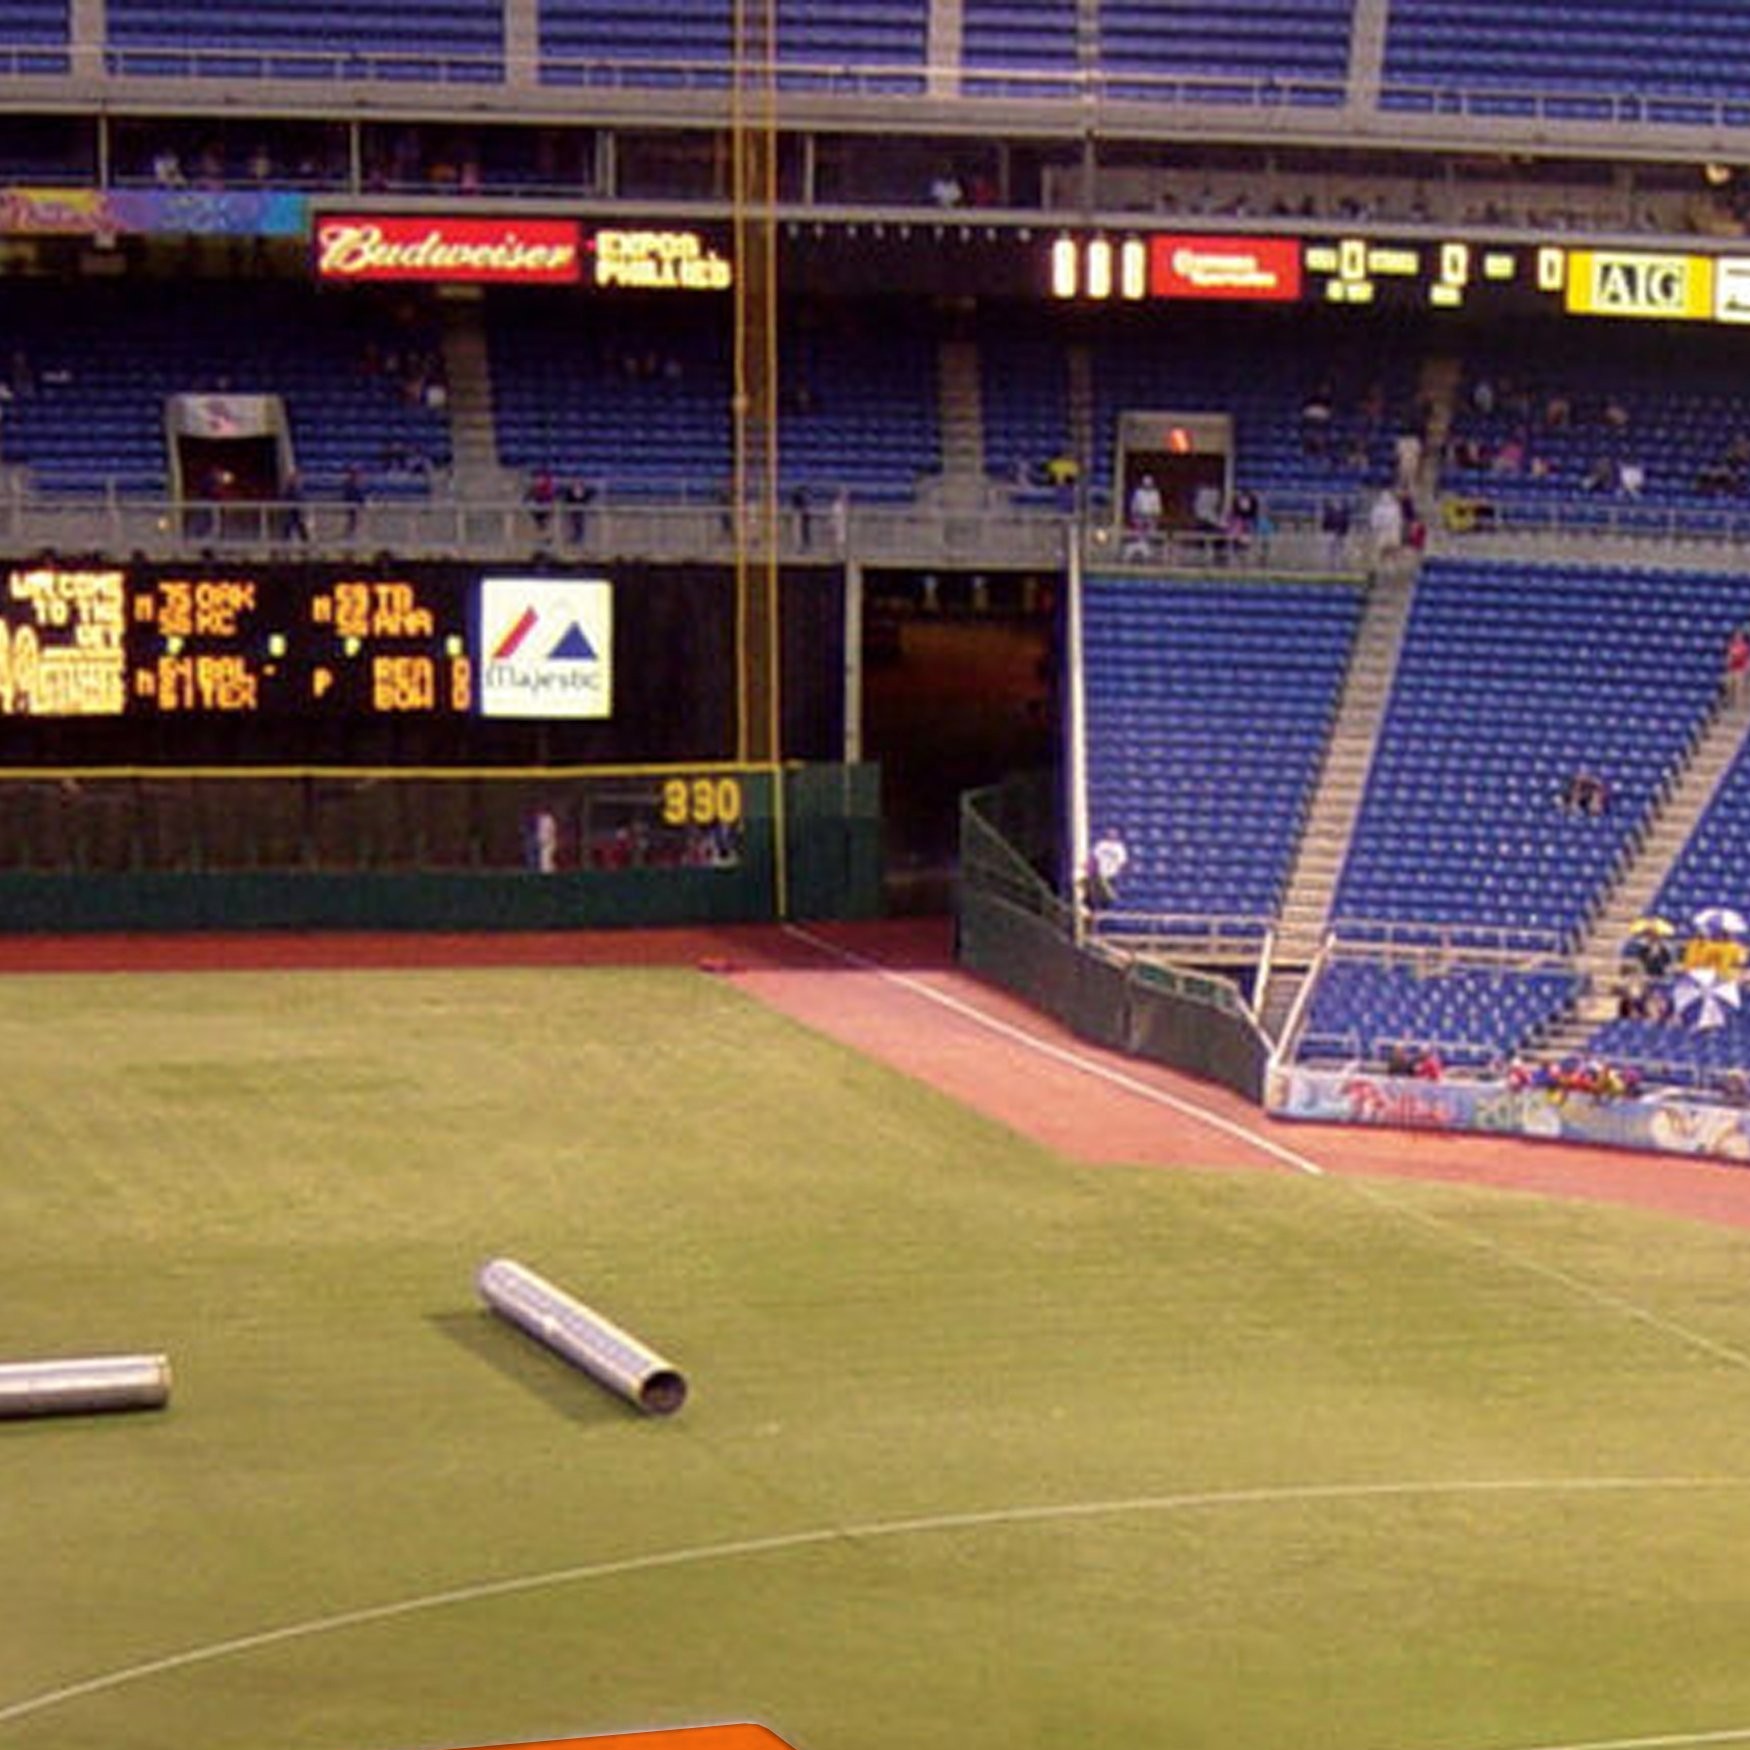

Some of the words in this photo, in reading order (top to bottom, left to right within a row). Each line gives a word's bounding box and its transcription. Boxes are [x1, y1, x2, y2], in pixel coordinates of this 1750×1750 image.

[319, 225, 574, 275] Budweiser
[486, 664, 599, 696] Majestic
[663, 779, 740, 824] 330
